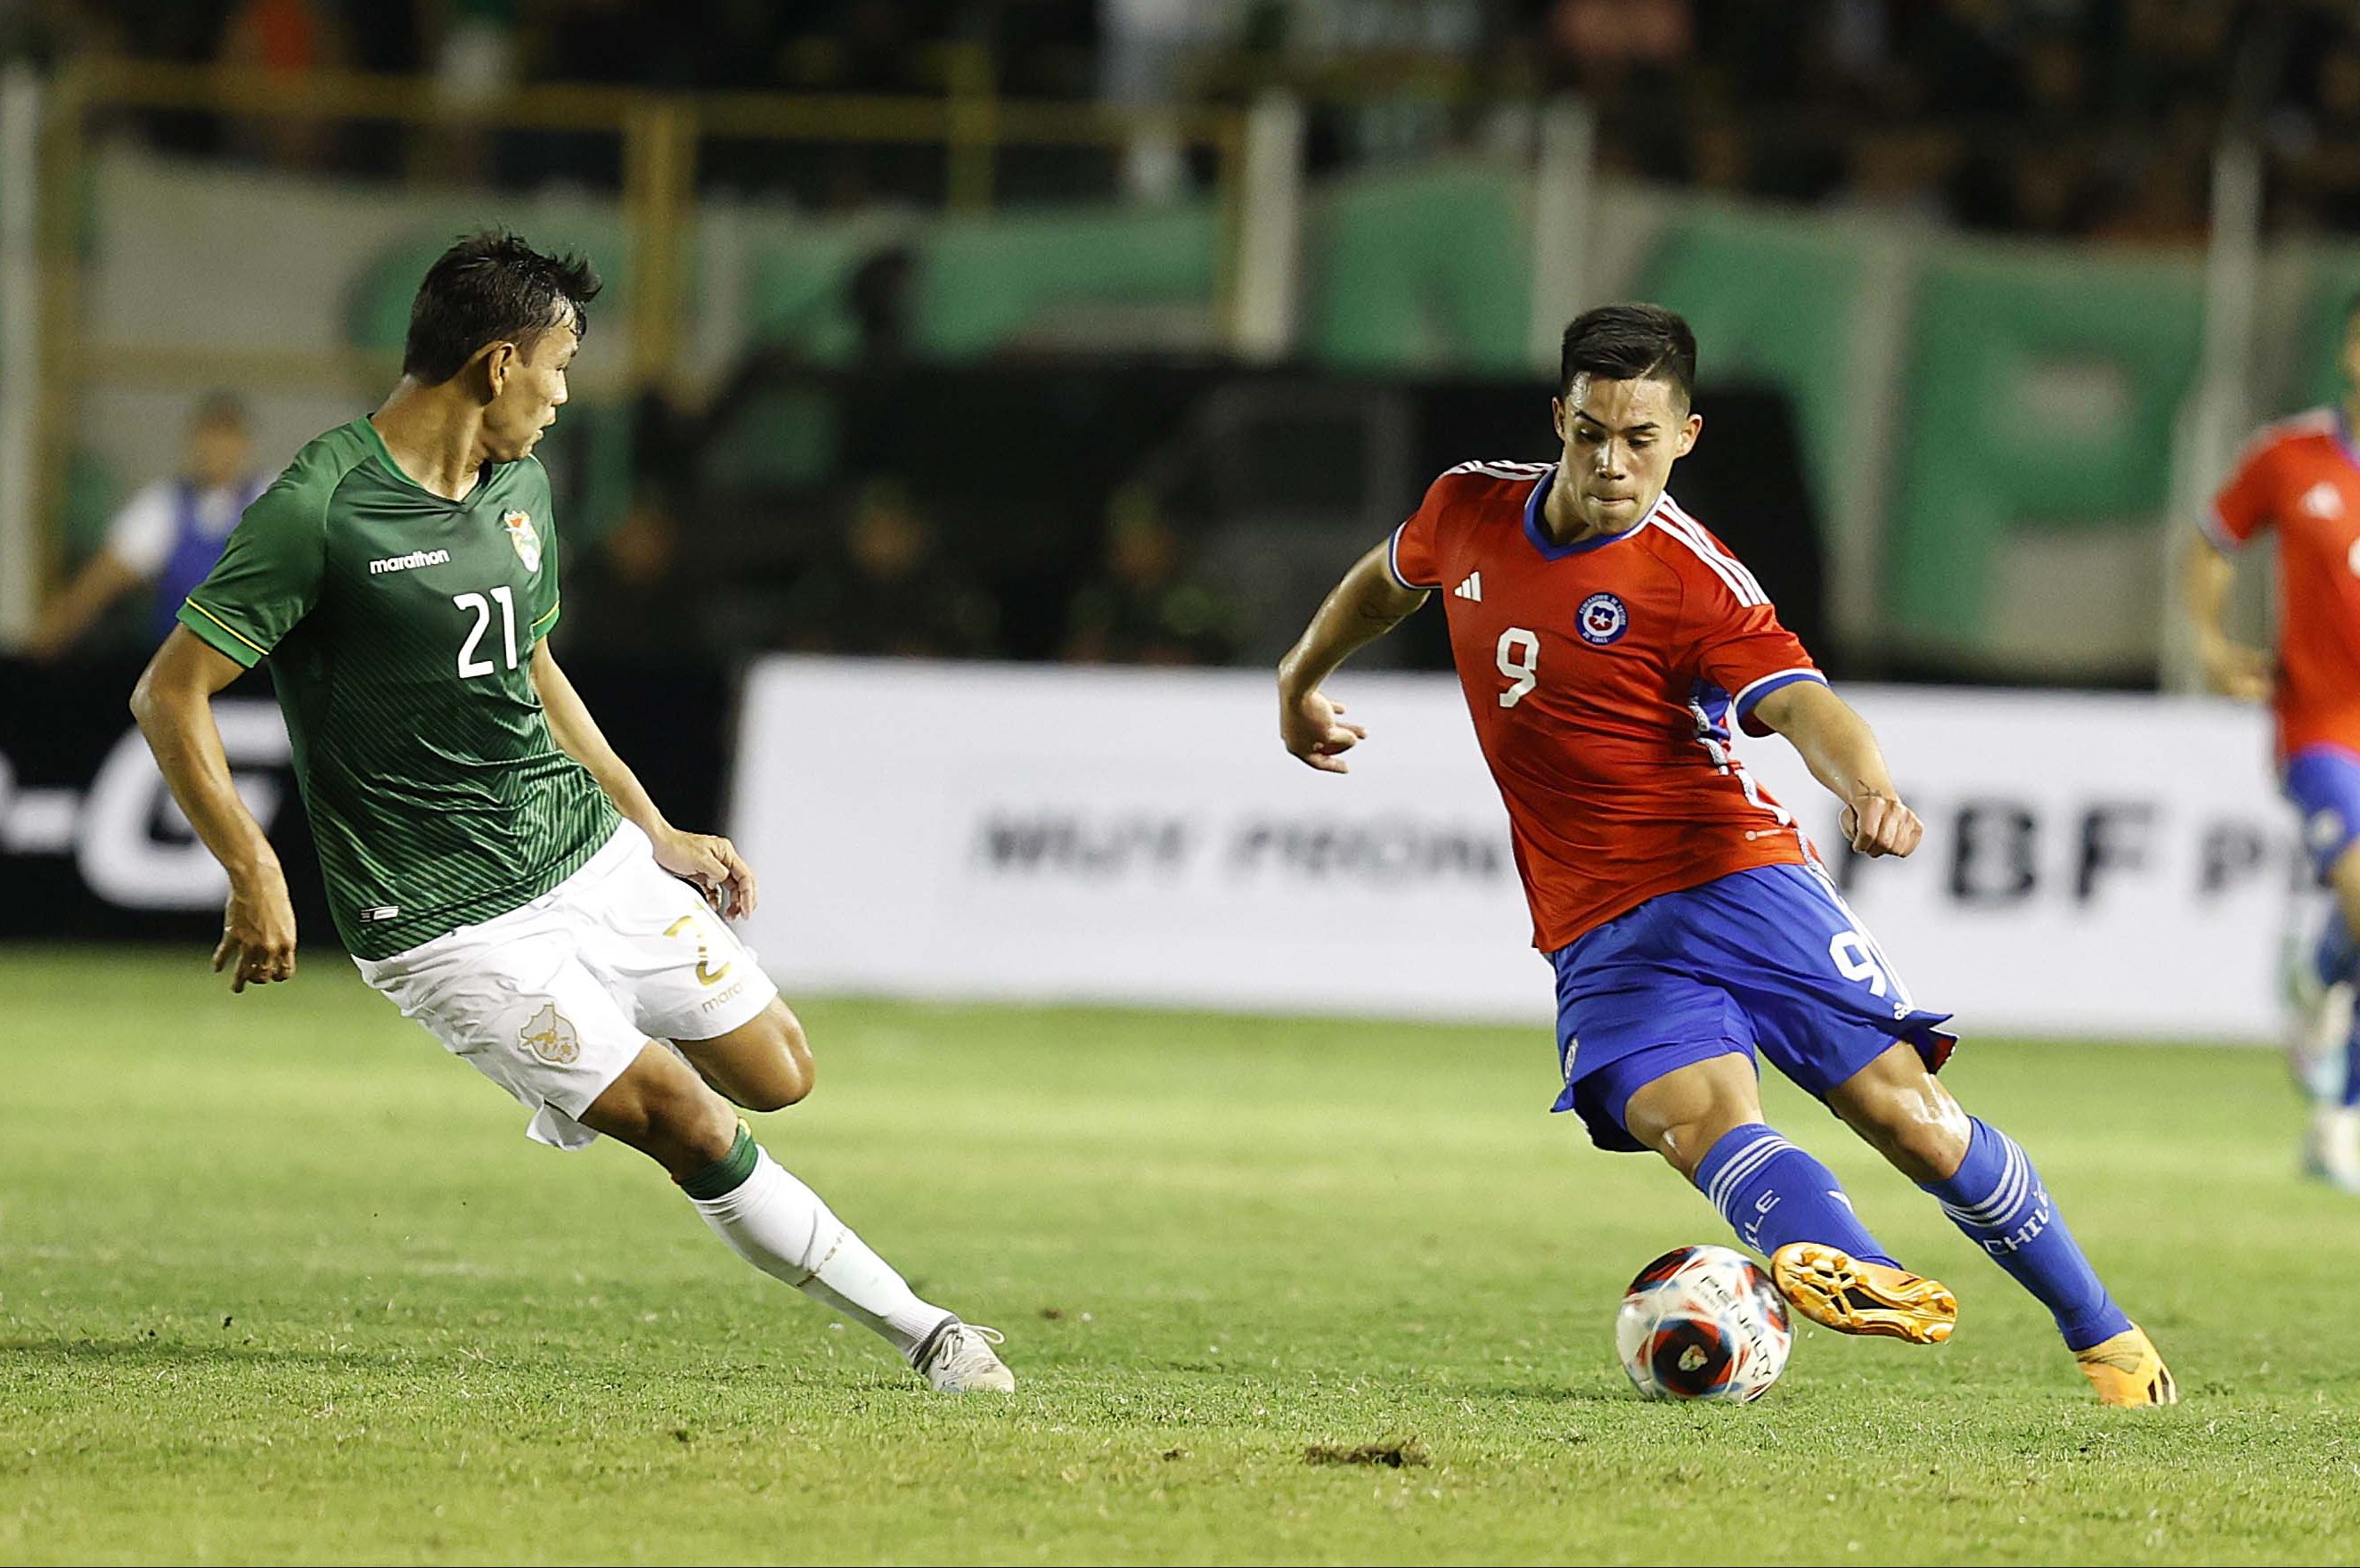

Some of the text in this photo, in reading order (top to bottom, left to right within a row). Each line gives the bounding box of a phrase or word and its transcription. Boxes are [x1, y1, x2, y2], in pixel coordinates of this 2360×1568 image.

[370, 550, 450, 575] marathon
[453, 585, 518, 679] 21
[1497, 627, 1539, 707] 9
[701, 983, 743, 1013] mara
[1829, 930, 1887, 998] 9
[1983, 1180, 2049, 1254] CHILE
